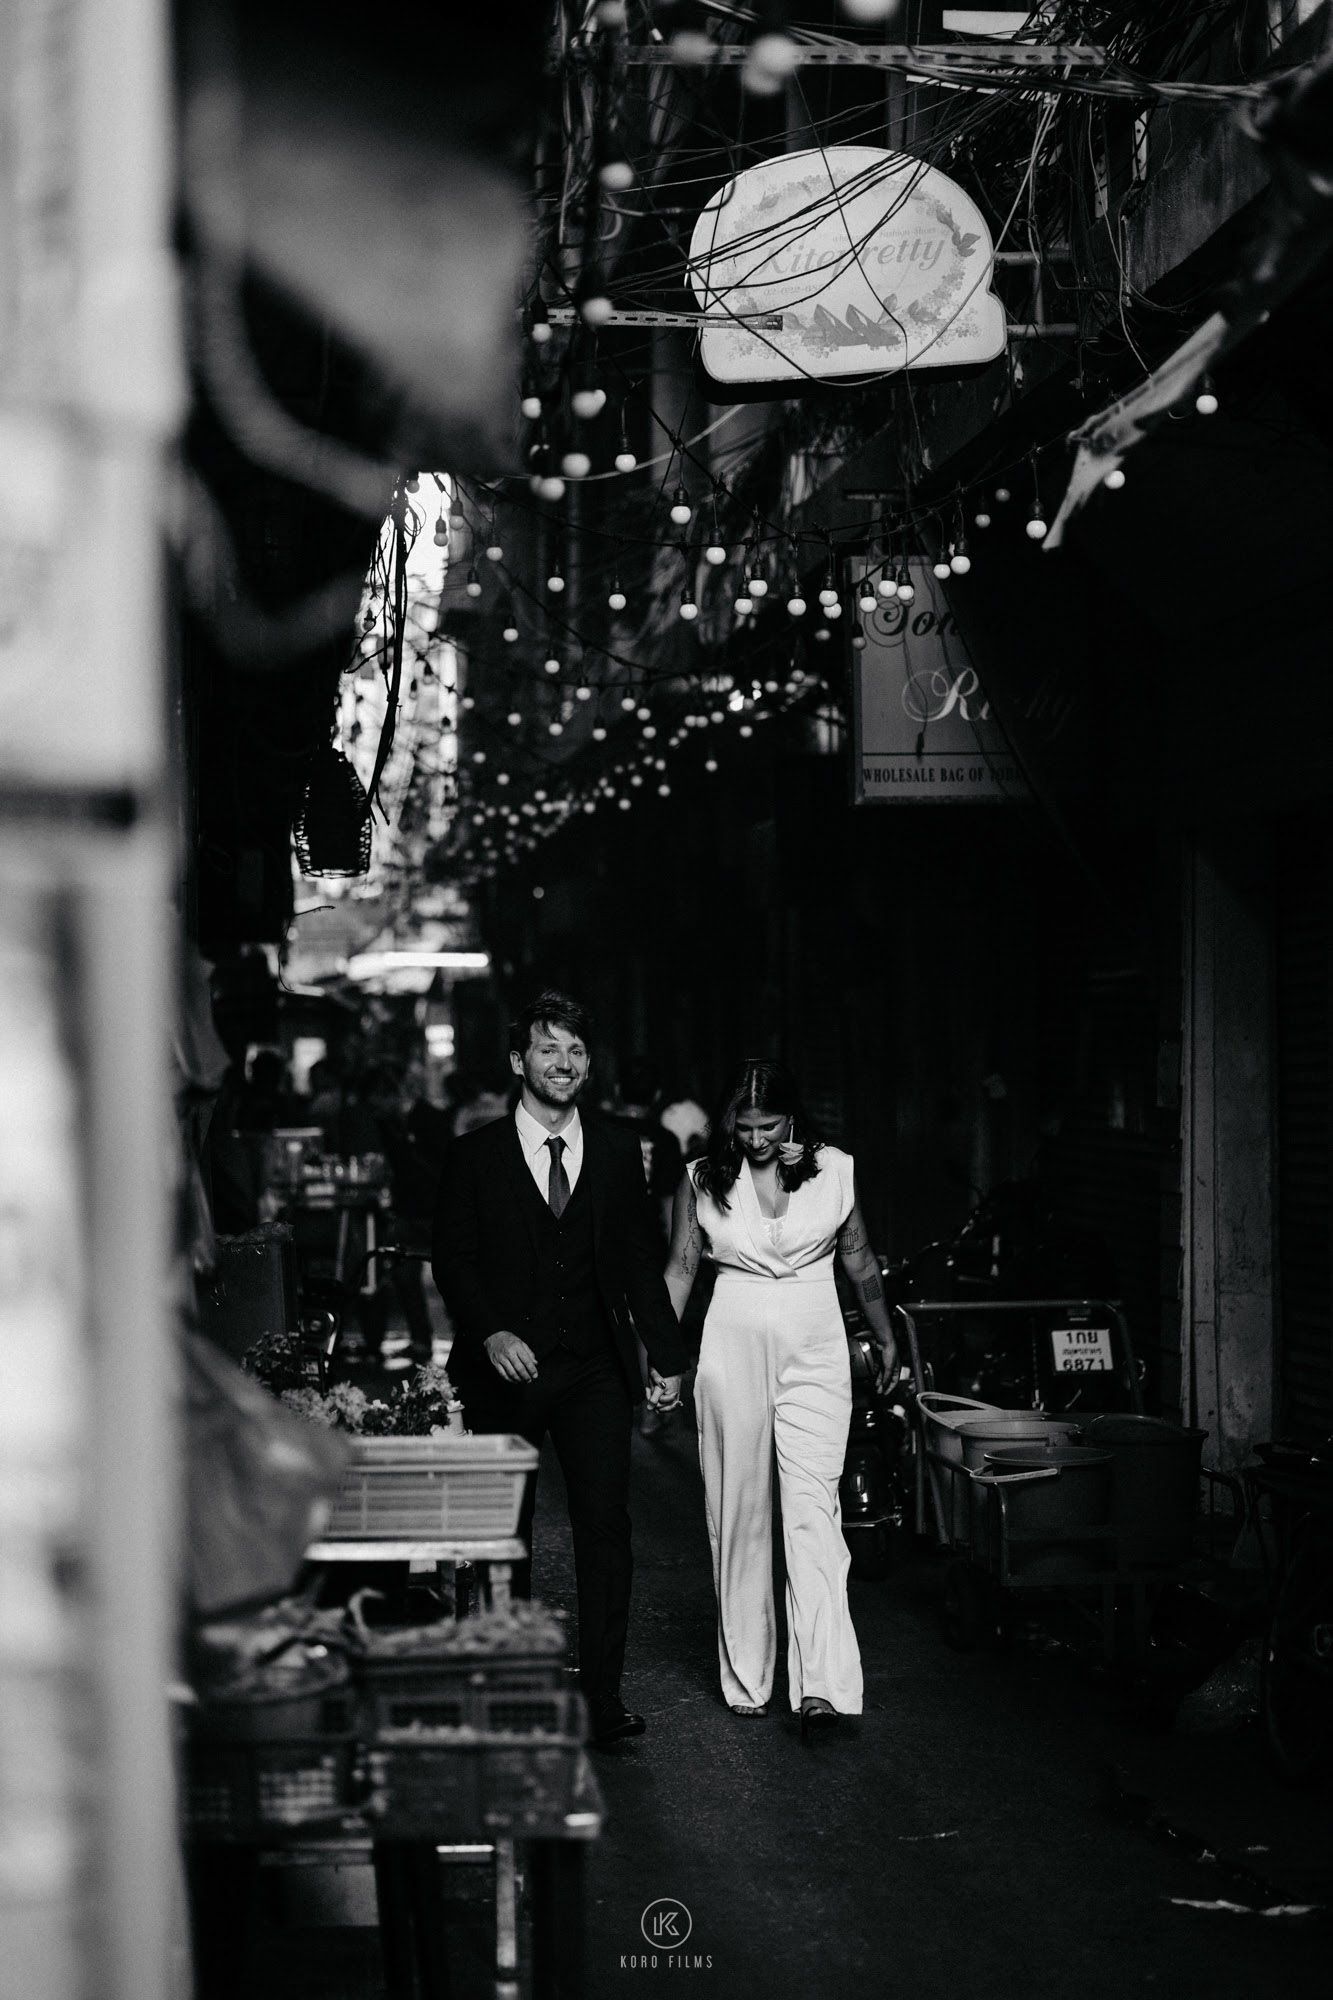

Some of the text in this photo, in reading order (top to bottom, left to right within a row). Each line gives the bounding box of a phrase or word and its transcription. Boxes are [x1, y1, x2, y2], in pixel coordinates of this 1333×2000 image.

[863, 767, 935, 783] WHOLESALE
[940, 767, 964, 783] BAG
[968, 767, 985, 783] OF
[1063, 1358, 1105, 1371] 6871
